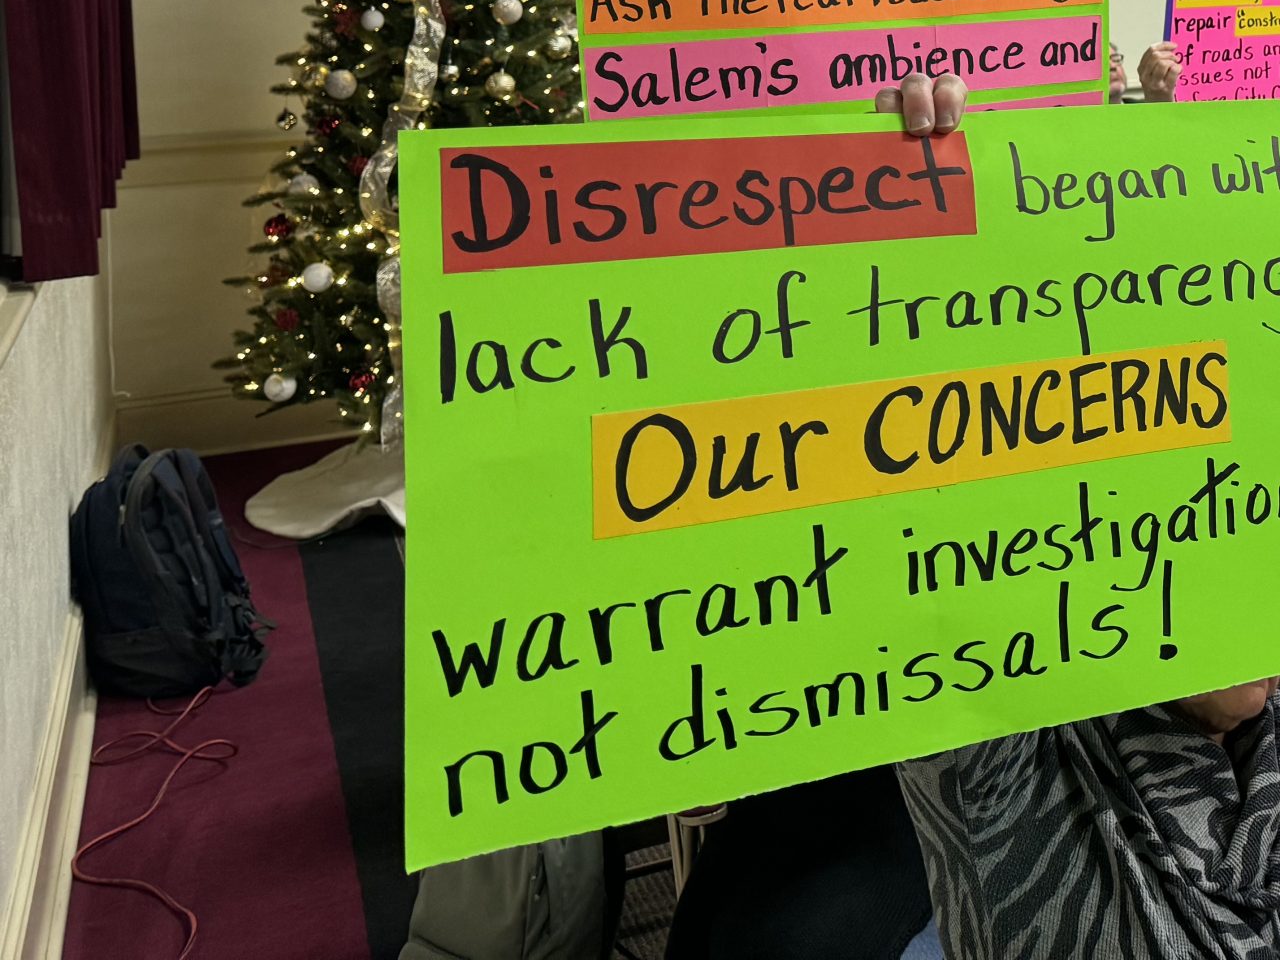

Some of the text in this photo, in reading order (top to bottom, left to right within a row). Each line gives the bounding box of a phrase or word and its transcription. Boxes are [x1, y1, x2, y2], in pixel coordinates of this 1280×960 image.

[593, 22, 1099, 113] Salem's ambience and
[1174, 12, 1231, 41] repair
[1174, 44, 1194, 66] of
[1202, 39, 1253, 64] roads
[1178, 65, 1234, 87] ssues
[1244, 62, 1272, 80] not
[450, 135, 965, 252] Disrespect
[1009, 141, 1187, 241] began
[439, 298, 648, 404] lack
[712, 270, 811, 364] of
[615, 352, 1228, 522] Our CONCERNS
[431, 524, 848, 698] warrant
[444, 559, 1178, 817] not dismissals!
